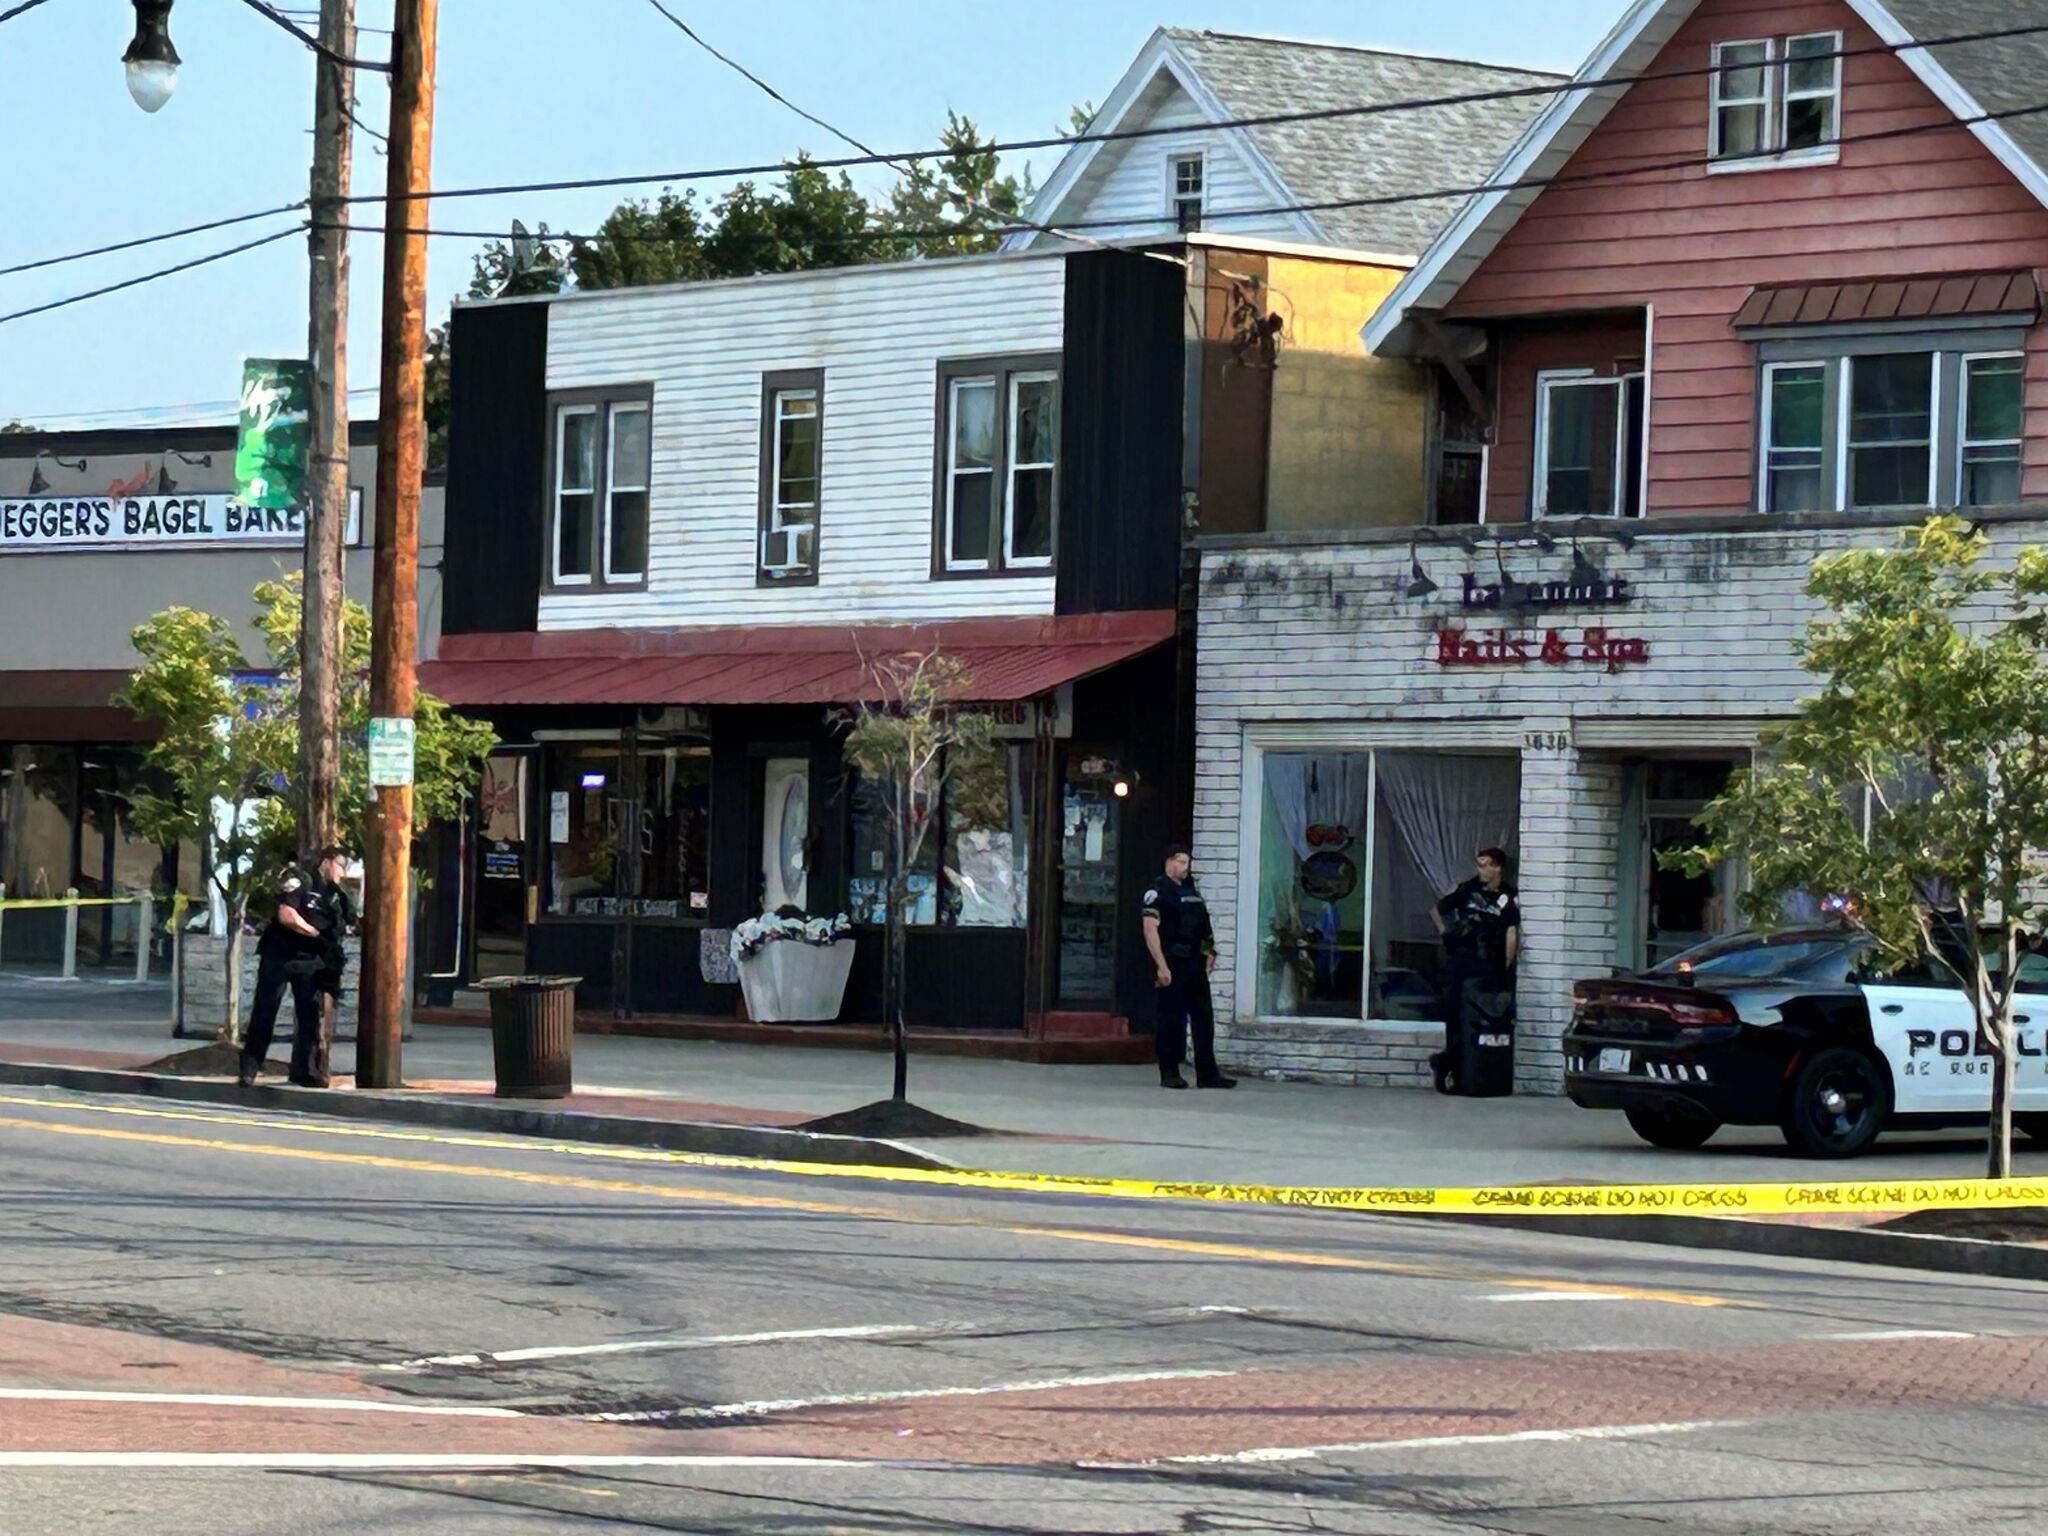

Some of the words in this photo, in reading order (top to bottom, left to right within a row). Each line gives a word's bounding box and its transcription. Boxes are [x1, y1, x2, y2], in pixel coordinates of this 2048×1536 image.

[0, 501, 110, 537] EGGER'S
[124, 498, 214, 535] BAGEL
[1541, 627, 1569, 664] &
[1905, 1029, 2048, 1057] POLC
